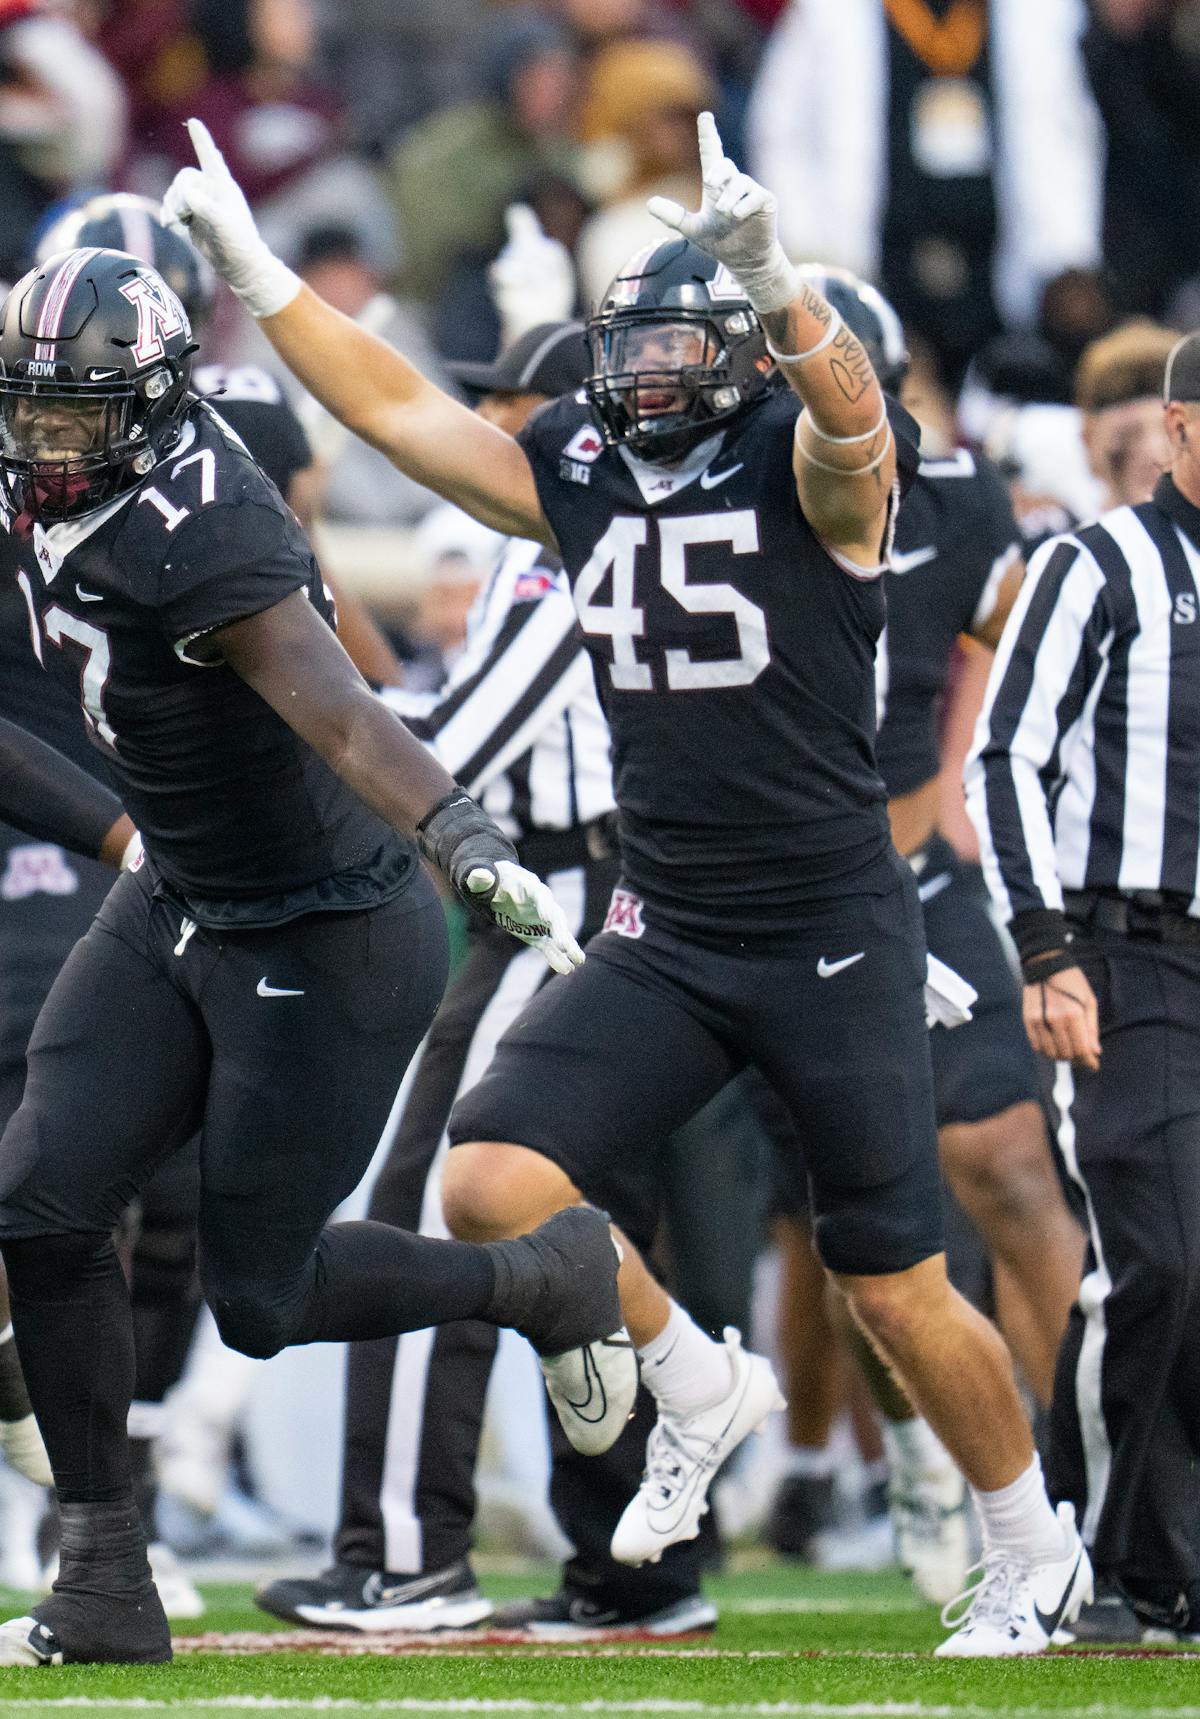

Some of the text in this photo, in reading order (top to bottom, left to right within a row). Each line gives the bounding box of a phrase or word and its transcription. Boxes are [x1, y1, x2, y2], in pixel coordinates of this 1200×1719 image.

[28, 361, 56, 377] ROW
[138, 448, 216, 531] 17
[573, 509, 771, 691] 45
[1174, 592, 1197, 624] S
